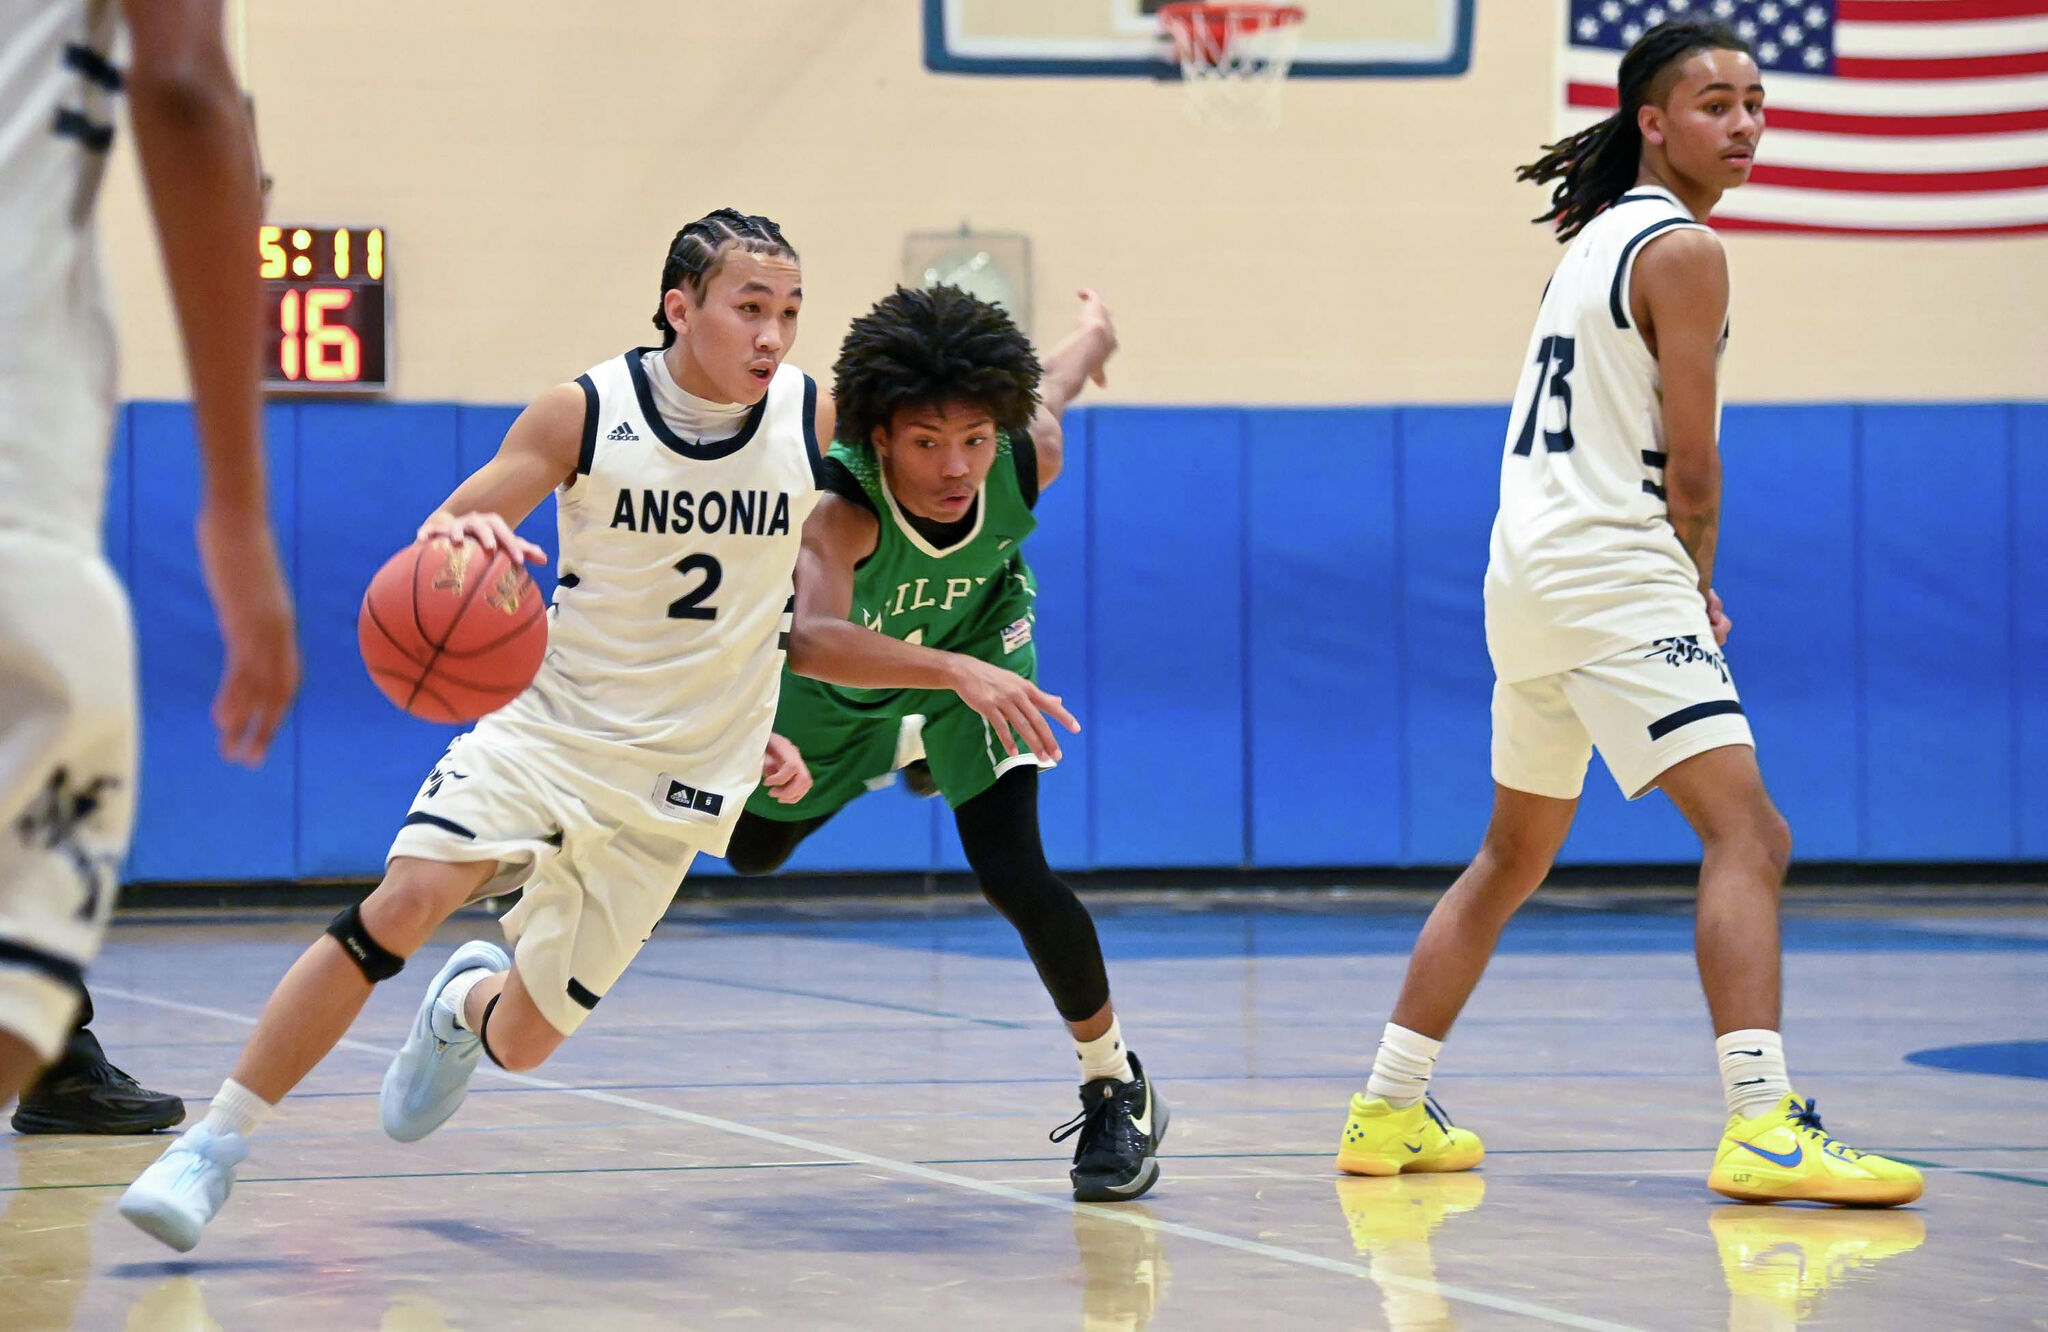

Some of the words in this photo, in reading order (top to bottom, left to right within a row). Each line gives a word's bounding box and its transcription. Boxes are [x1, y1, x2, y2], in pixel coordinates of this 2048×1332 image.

[259, 225, 383, 280] 5:11
[280, 288, 361, 382] 16
[1513, 334, 1576, 457] 13
[610, 488, 790, 536] ANSONIA
[667, 553, 723, 621] 2
